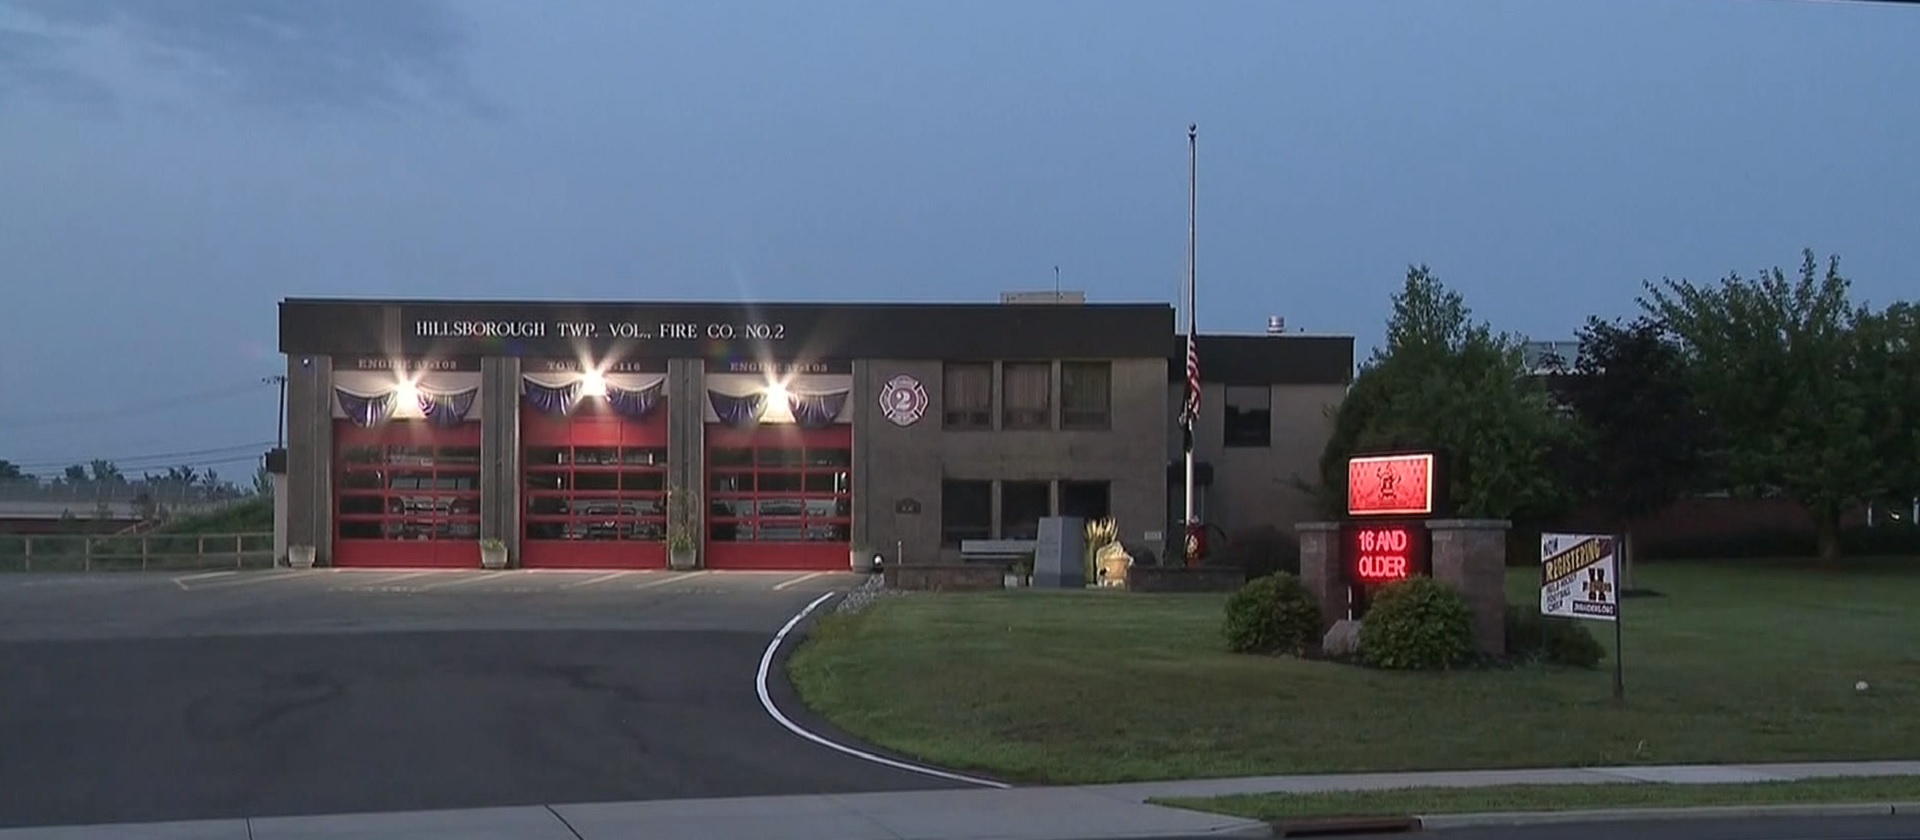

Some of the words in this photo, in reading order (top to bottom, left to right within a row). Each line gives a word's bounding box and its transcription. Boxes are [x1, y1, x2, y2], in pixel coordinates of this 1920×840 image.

[415, 320, 545, 337] HILLSBOROUGH
[556, 321, 599, 338] TWP.
[659, 322, 698, 339] FIRE
[706, 322, 737, 339] CO.
[358, 359, 412, 369] ENGINE
[729, 361, 782, 372] ENGINE
[895, 391, 911, 411] 2
[1358, 529, 1375, 551] 16
[1375, 529, 1407, 552] AND
[1358, 555, 1407, 578] OLDER
[1545, 538, 1600, 580] REGISTERING
